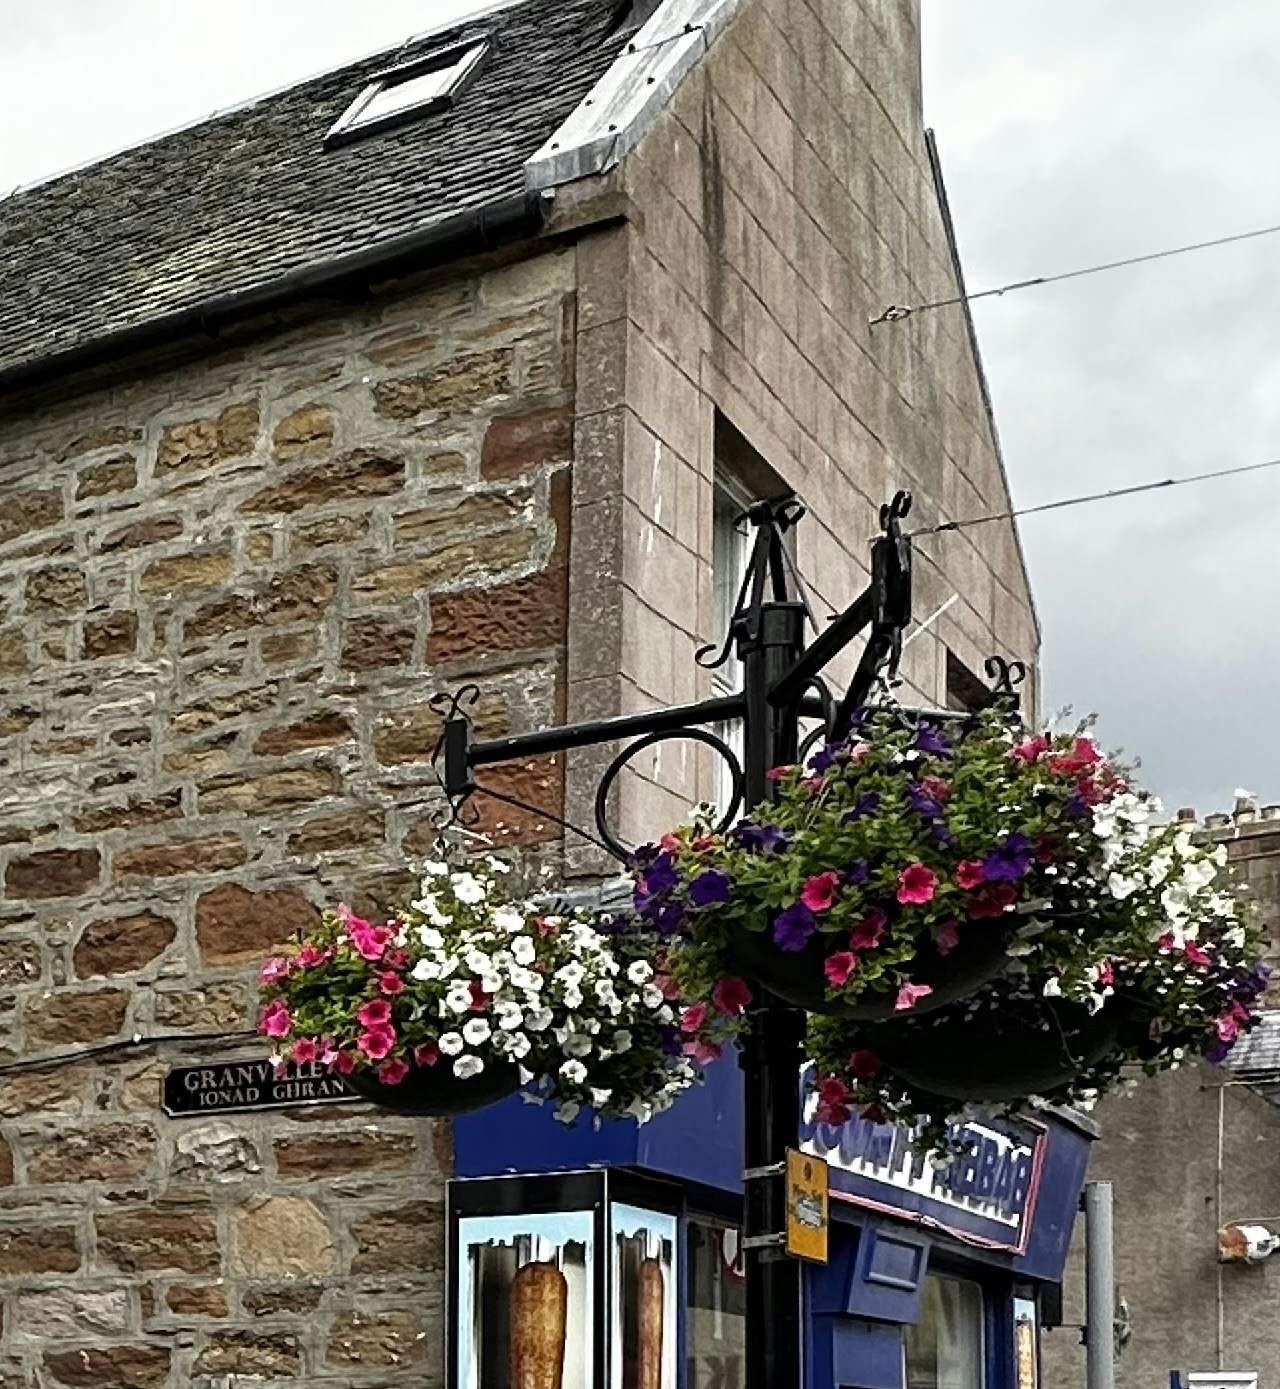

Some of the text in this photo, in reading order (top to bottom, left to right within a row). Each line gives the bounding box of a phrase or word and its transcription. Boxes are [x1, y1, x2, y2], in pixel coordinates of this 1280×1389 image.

[184, 1060, 322, 1090] GRANVLLE
[199, 1079, 345, 1106] IONAD GHRAN
